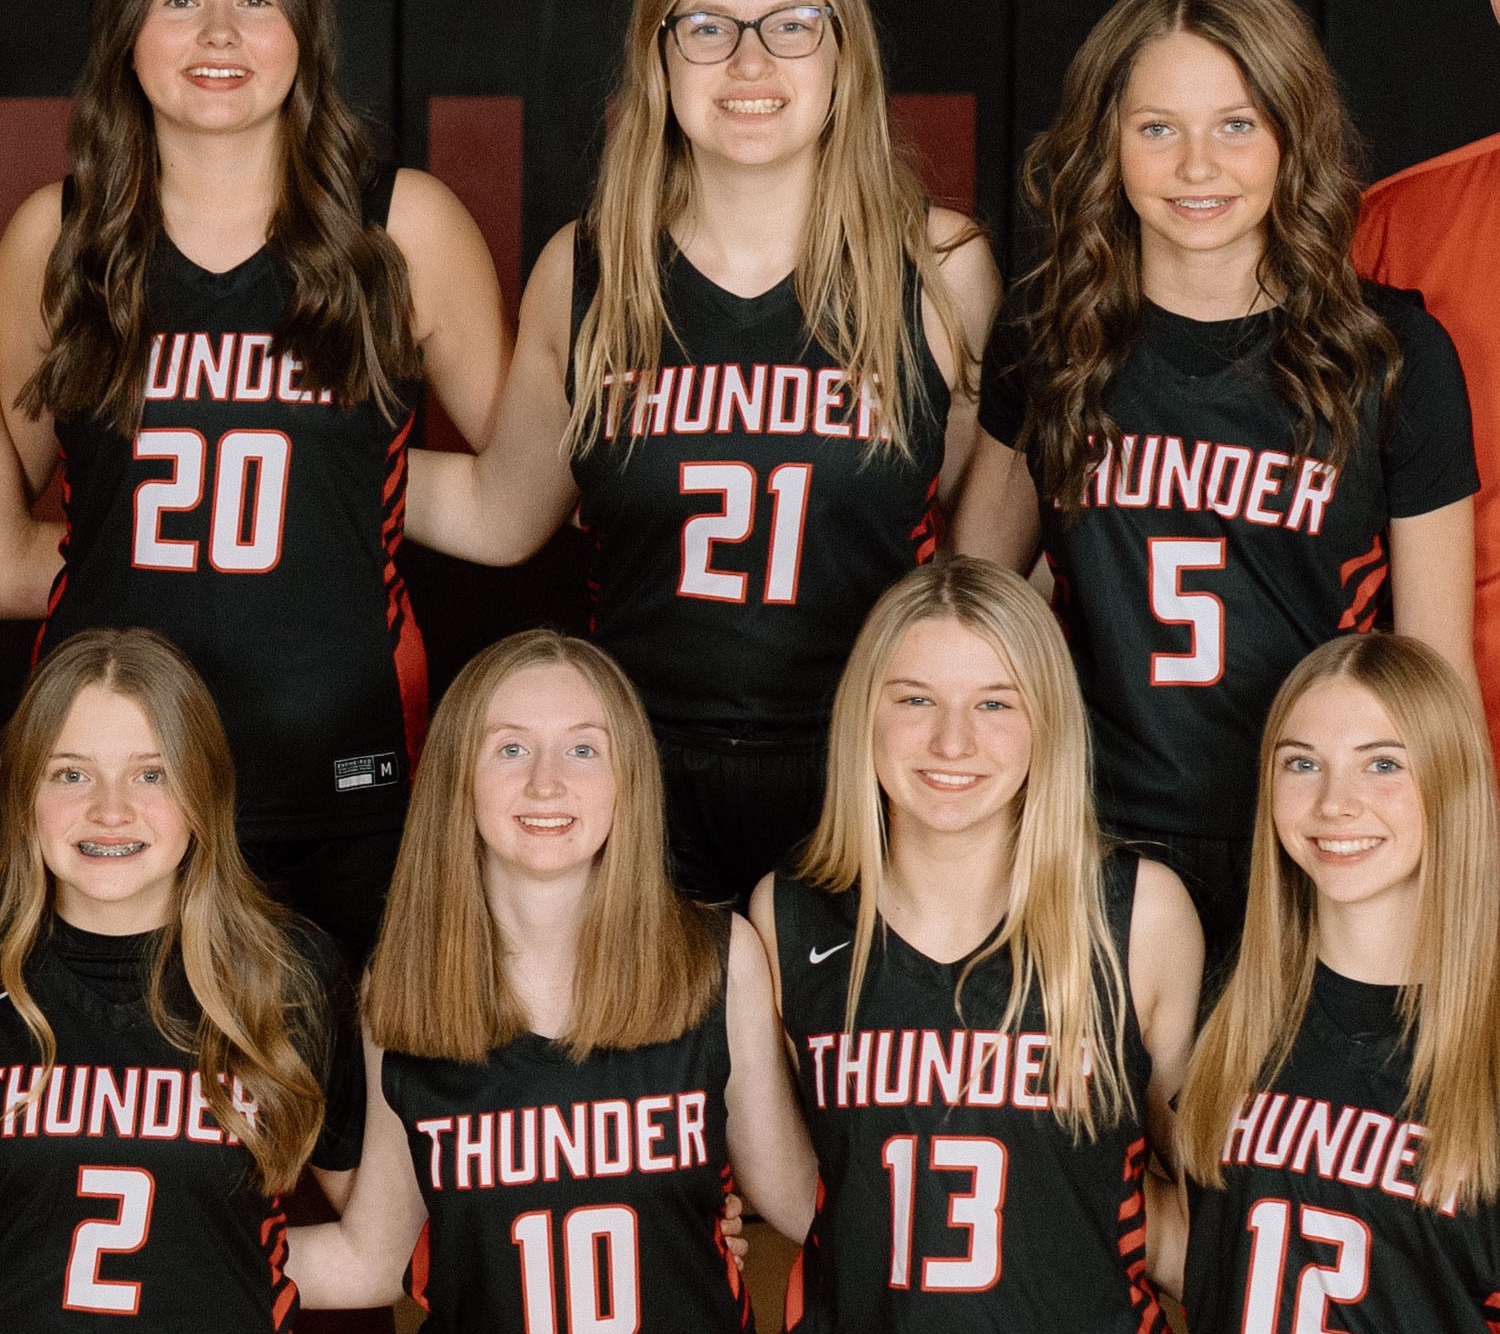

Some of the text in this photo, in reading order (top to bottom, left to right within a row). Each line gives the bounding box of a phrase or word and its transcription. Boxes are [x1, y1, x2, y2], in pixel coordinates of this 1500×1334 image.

[142, 331, 335, 405] UNDE
[131, 428, 293, 574] 20
[676, 460, 814, 606] 21
[1146, 536, 1228, 687] 5
[380, 760, 393, 778] M
[416, 1089, 710, 1193] THUNDER
[881, 1133, 1009, 1293] 13
[1220, 1091, 1460, 1218] HUNDE
[62, 1164, 157, 1317] 2
